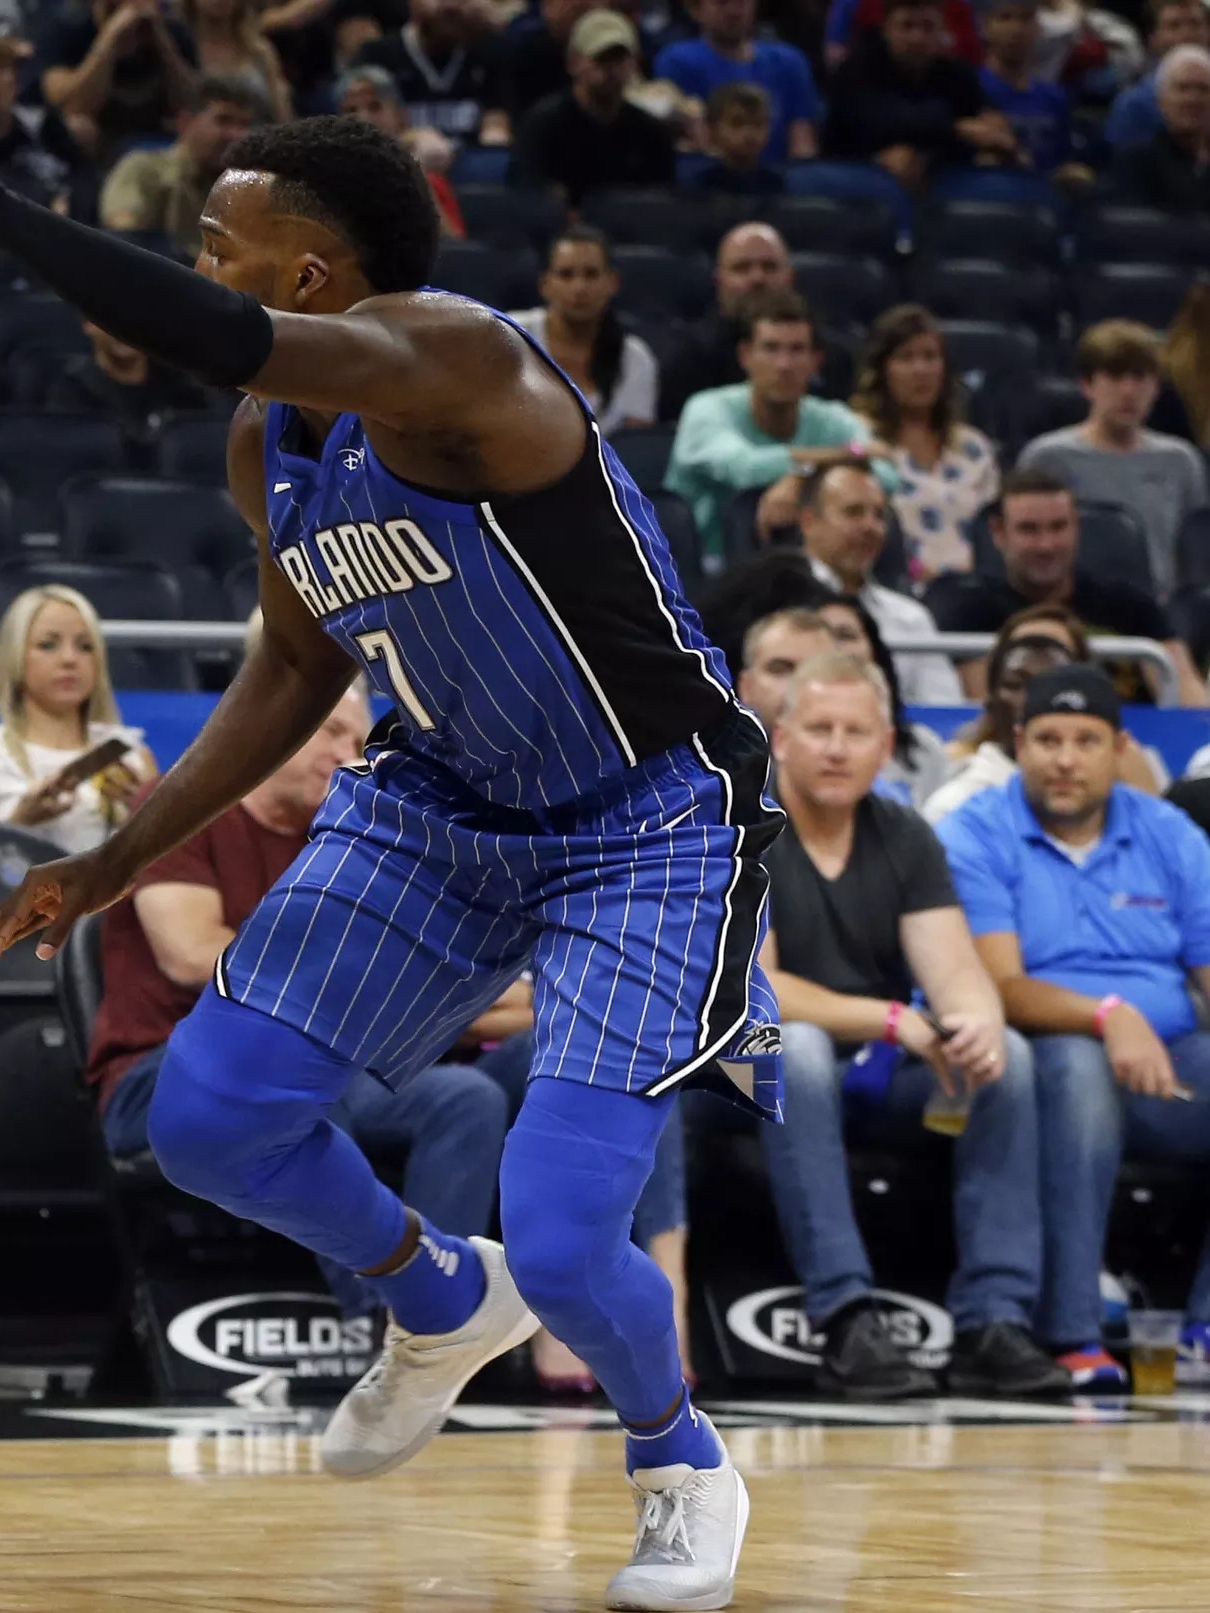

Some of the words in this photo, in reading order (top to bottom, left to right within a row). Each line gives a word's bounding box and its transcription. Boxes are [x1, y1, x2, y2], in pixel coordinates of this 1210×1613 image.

[279, 518, 453, 619] RLANDO
[354, 628, 437, 731] 7
[215, 1316, 374, 1356] FIELDS
